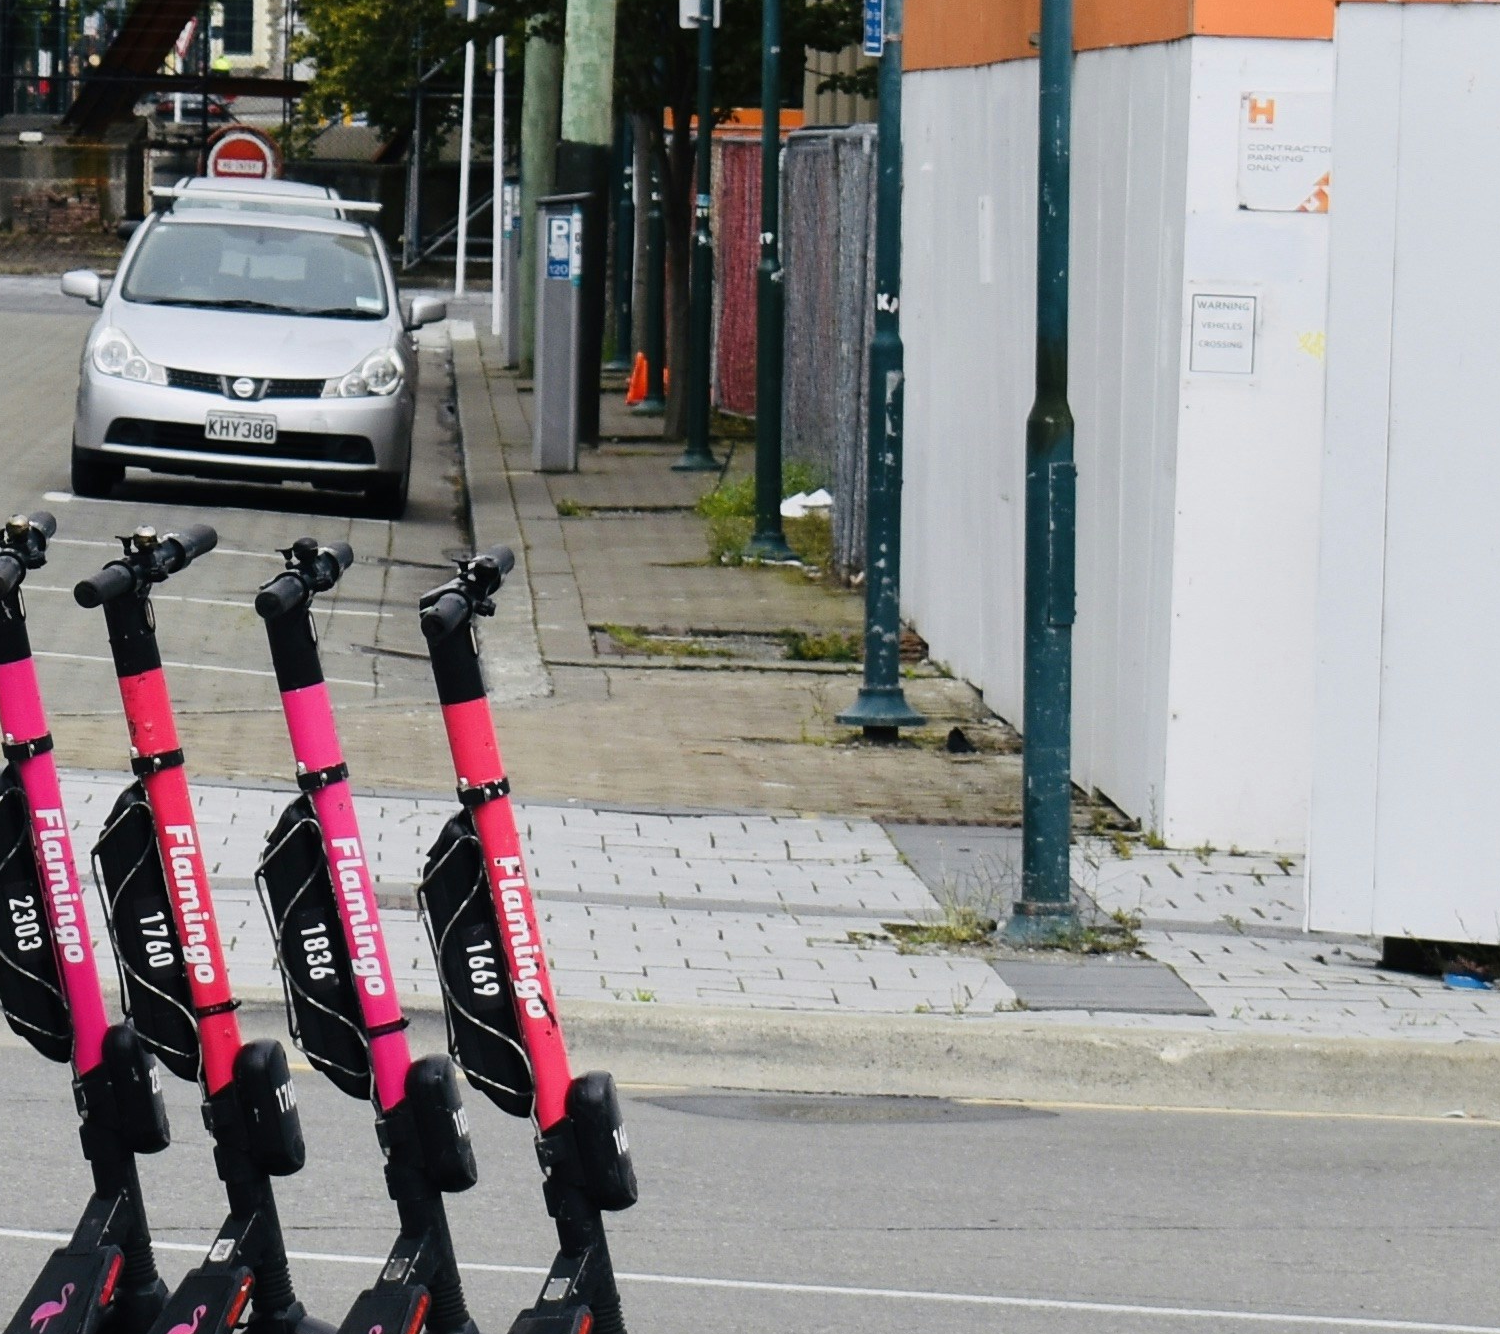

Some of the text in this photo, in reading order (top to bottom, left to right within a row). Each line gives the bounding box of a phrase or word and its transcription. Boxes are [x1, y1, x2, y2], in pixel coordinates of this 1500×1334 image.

[1247, 154, 1304, 163] PARKING
[1247, 163, 1280, 172] ONLY
[1196, 300, 1250, 311] WARNING
[1201, 322, 1243, 330] VEHICLES
[1199, 339, 1243, 349] CROSSING
[35, 808, 84, 964] Flamingo
[165, 824, 215, 984] Flamingo
[8, 895, 43, 952] 2303
[139, 911, 175, 968] 1760
[331, 836, 385, 996] Flamingo
[493, 855, 547, 1018] Flamingo
[300, 922, 336, 980] 1836
[465, 940, 500, 996] 1669
